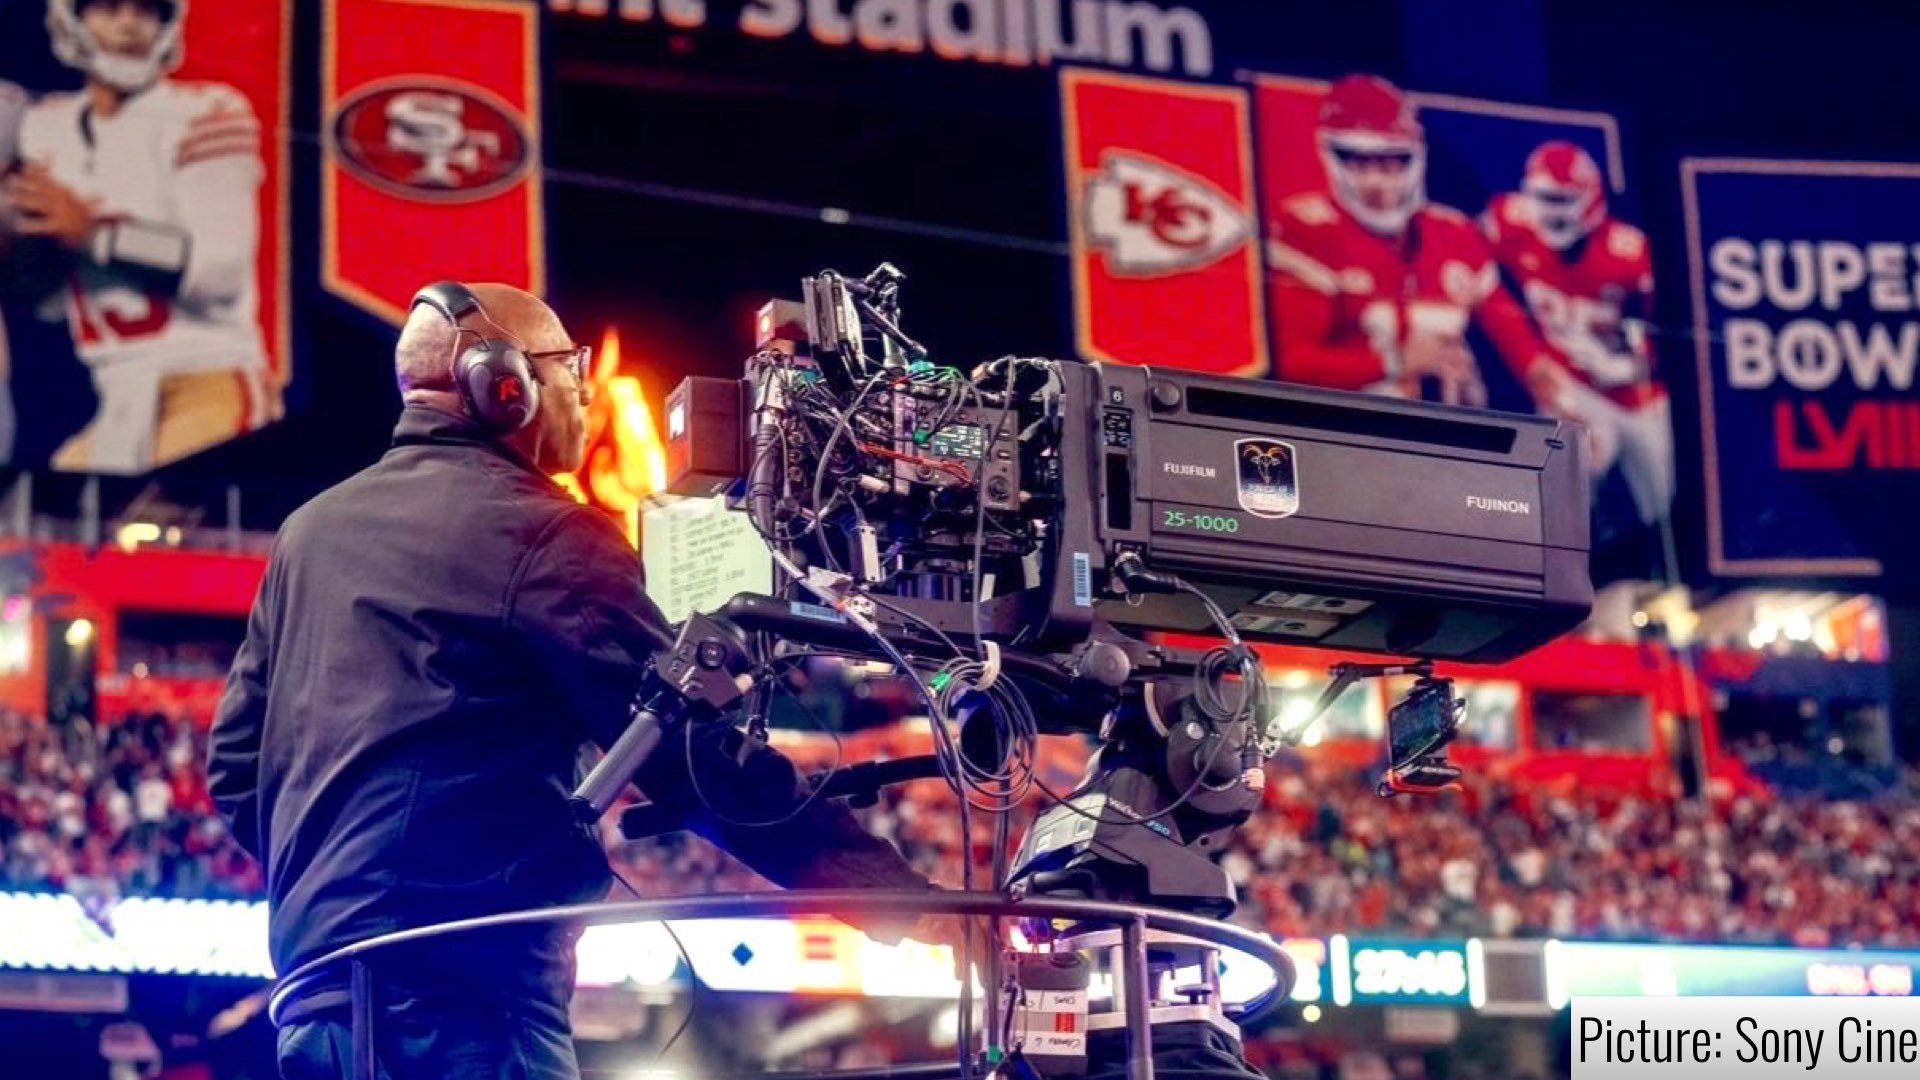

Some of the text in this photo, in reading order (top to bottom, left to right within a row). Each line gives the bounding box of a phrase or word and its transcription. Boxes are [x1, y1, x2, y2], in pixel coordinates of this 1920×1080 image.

[1709, 236, 1920, 311] SUPE
[1164, 463, 1215, 478] FUJIFILM
[1465, 495, 1529, 514] FUJINON
[1163, 510, 1239, 532] 25-1000
